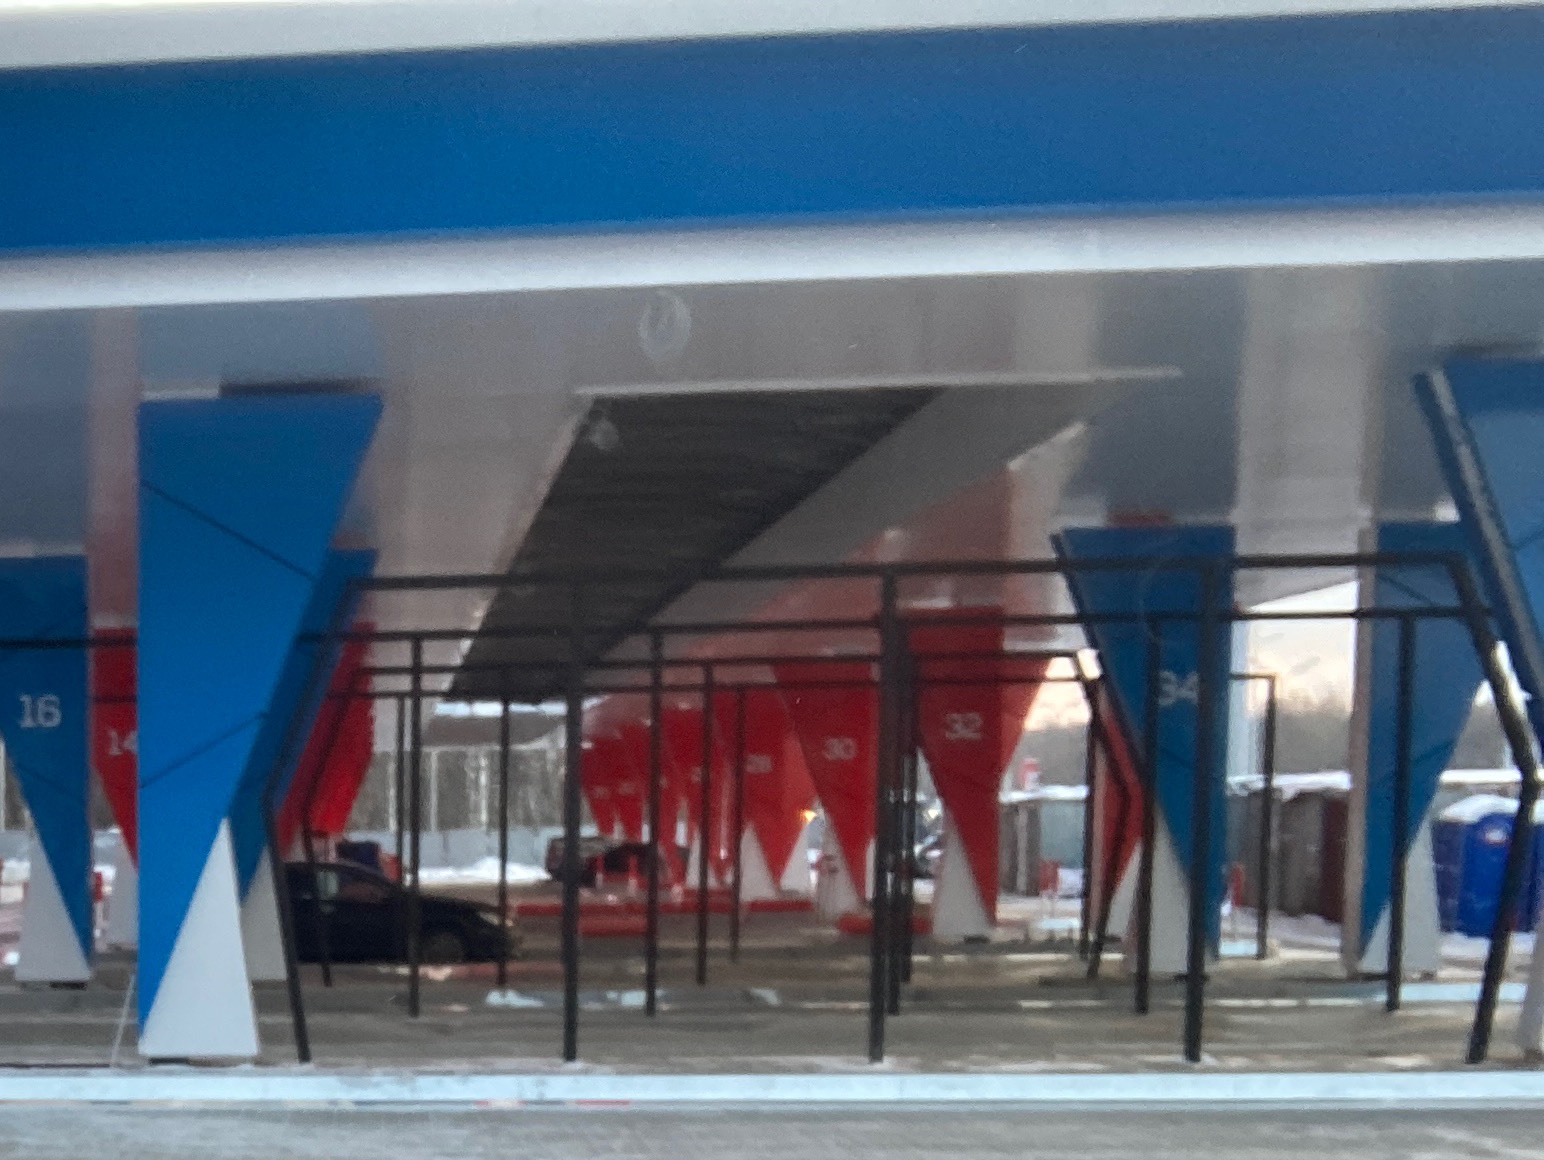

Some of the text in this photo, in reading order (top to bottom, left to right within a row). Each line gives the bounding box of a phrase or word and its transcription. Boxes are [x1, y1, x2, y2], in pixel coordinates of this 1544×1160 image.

[19, 693, 62, 728] 16
[945, 711, 984, 741] 32
[822, 736, 857, 761] 30
